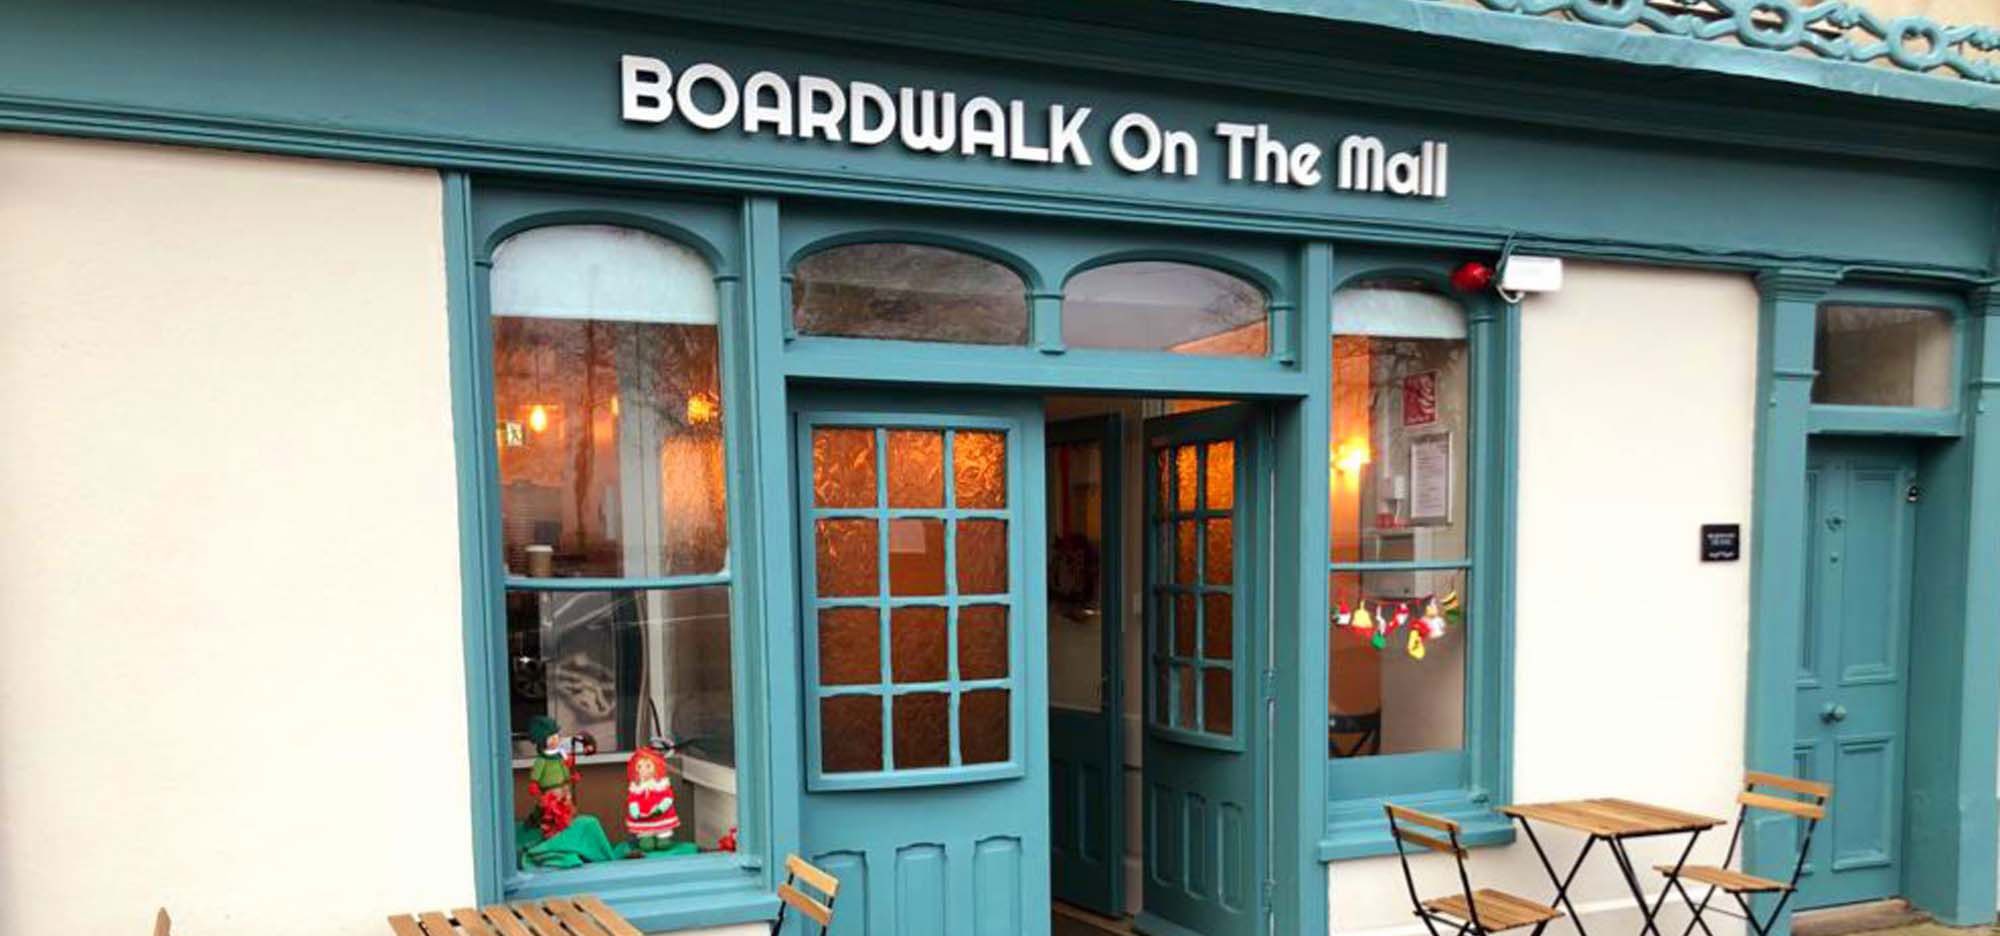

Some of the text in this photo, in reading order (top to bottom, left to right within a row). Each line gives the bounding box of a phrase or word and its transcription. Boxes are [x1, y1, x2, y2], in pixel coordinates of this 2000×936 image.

[621, 55, 1448, 198] BOARDWALK On The Mall
